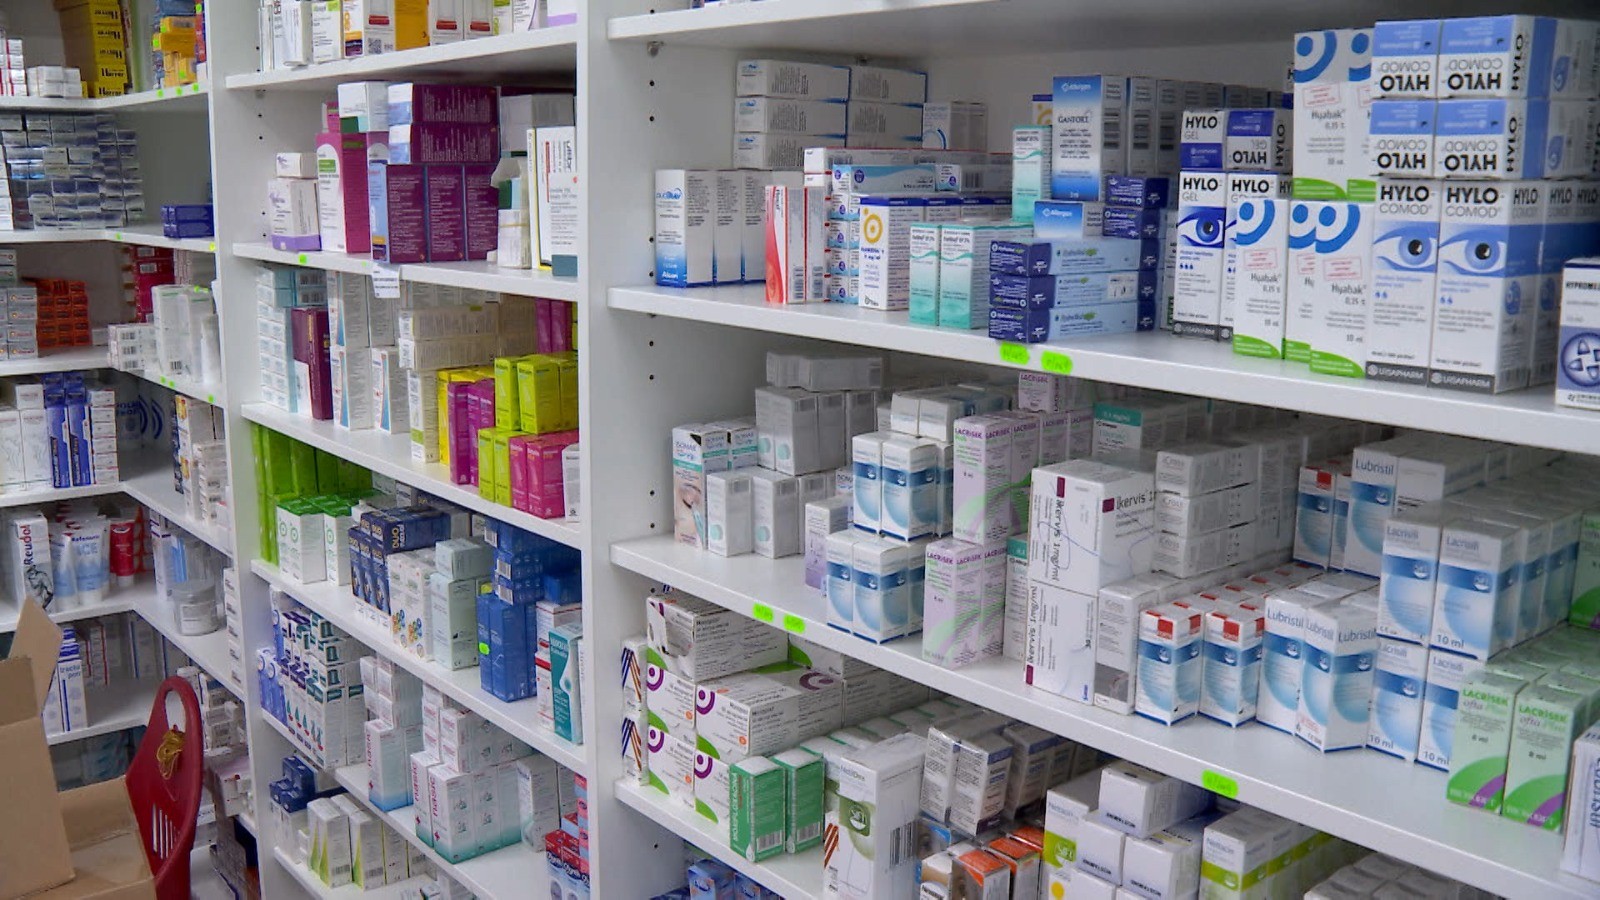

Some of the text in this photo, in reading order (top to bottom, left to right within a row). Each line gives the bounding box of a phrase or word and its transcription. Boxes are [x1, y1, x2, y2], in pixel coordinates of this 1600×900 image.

[1381, 61, 1430, 71] COMOD
[1449, 58, 1503, 71] COMOD
[1510, 34, 1524, 91] HYLO
[1380, 74, 1430, 91] HYLO
[1448, 73, 1501, 90] HYLO
[1057, 115, 1090, 124] GANFORT
[1186, 116, 1218, 129] HYLO
[1184, 131, 1199, 140] GEL
[1251, 140, 1267, 150] GEL
[1275, 124, 1285, 167] HYLO
[1378, 139, 1427, 151] COMOD
[1446, 140, 1497, 152] COMOD
[1506, 117, 1518, 173] HYLO
[1233, 150, 1267, 164] HYLO
[1377, 153, 1426, 169] HYLO
[1444, 154, 1497, 171] HYLO
[1183, 177, 1218, 191] HYLO
[1232, 179, 1269, 193] HYLO
[1279, 181, 1293, 194] HY
[1182, 192, 1198, 202] GEL
[1380, 186, 1430, 202] HYLO
[1447, 188, 1499, 204] HYLO
[1513, 187, 1538, 205] HYLO
[1550, 188, 1572, 204] HYLO
[1577, 188, 1598, 204] HYLO
[1379, 202, 1429, 216] COMOD
[1446, 205, 1498, 219] COMOD
[1251, 272, 1280, 284] Hyabak
[1331, 284, 1364, 296] Hyabak
[955, 428, 982, 440] LACRISEK
[1356, 458, 1394, 475] Lubristil
[926, 551, 954, 564] LACRISEK
[1267, 608, 1304, 628] Lubristil
[1306, 620, 1333, 641] Lubristil
[1338, 628, 1377, 643] Lubristil
[1437, 634, 1465, 649] 10 ml
[1463, 688, 1508, 706] LACRISEK
[1519, 704, 1568, 722] LACRISEK
[1369, 734, 1394, 749] 10 ml
[1424, 751, 1449, 766] 10 ml
